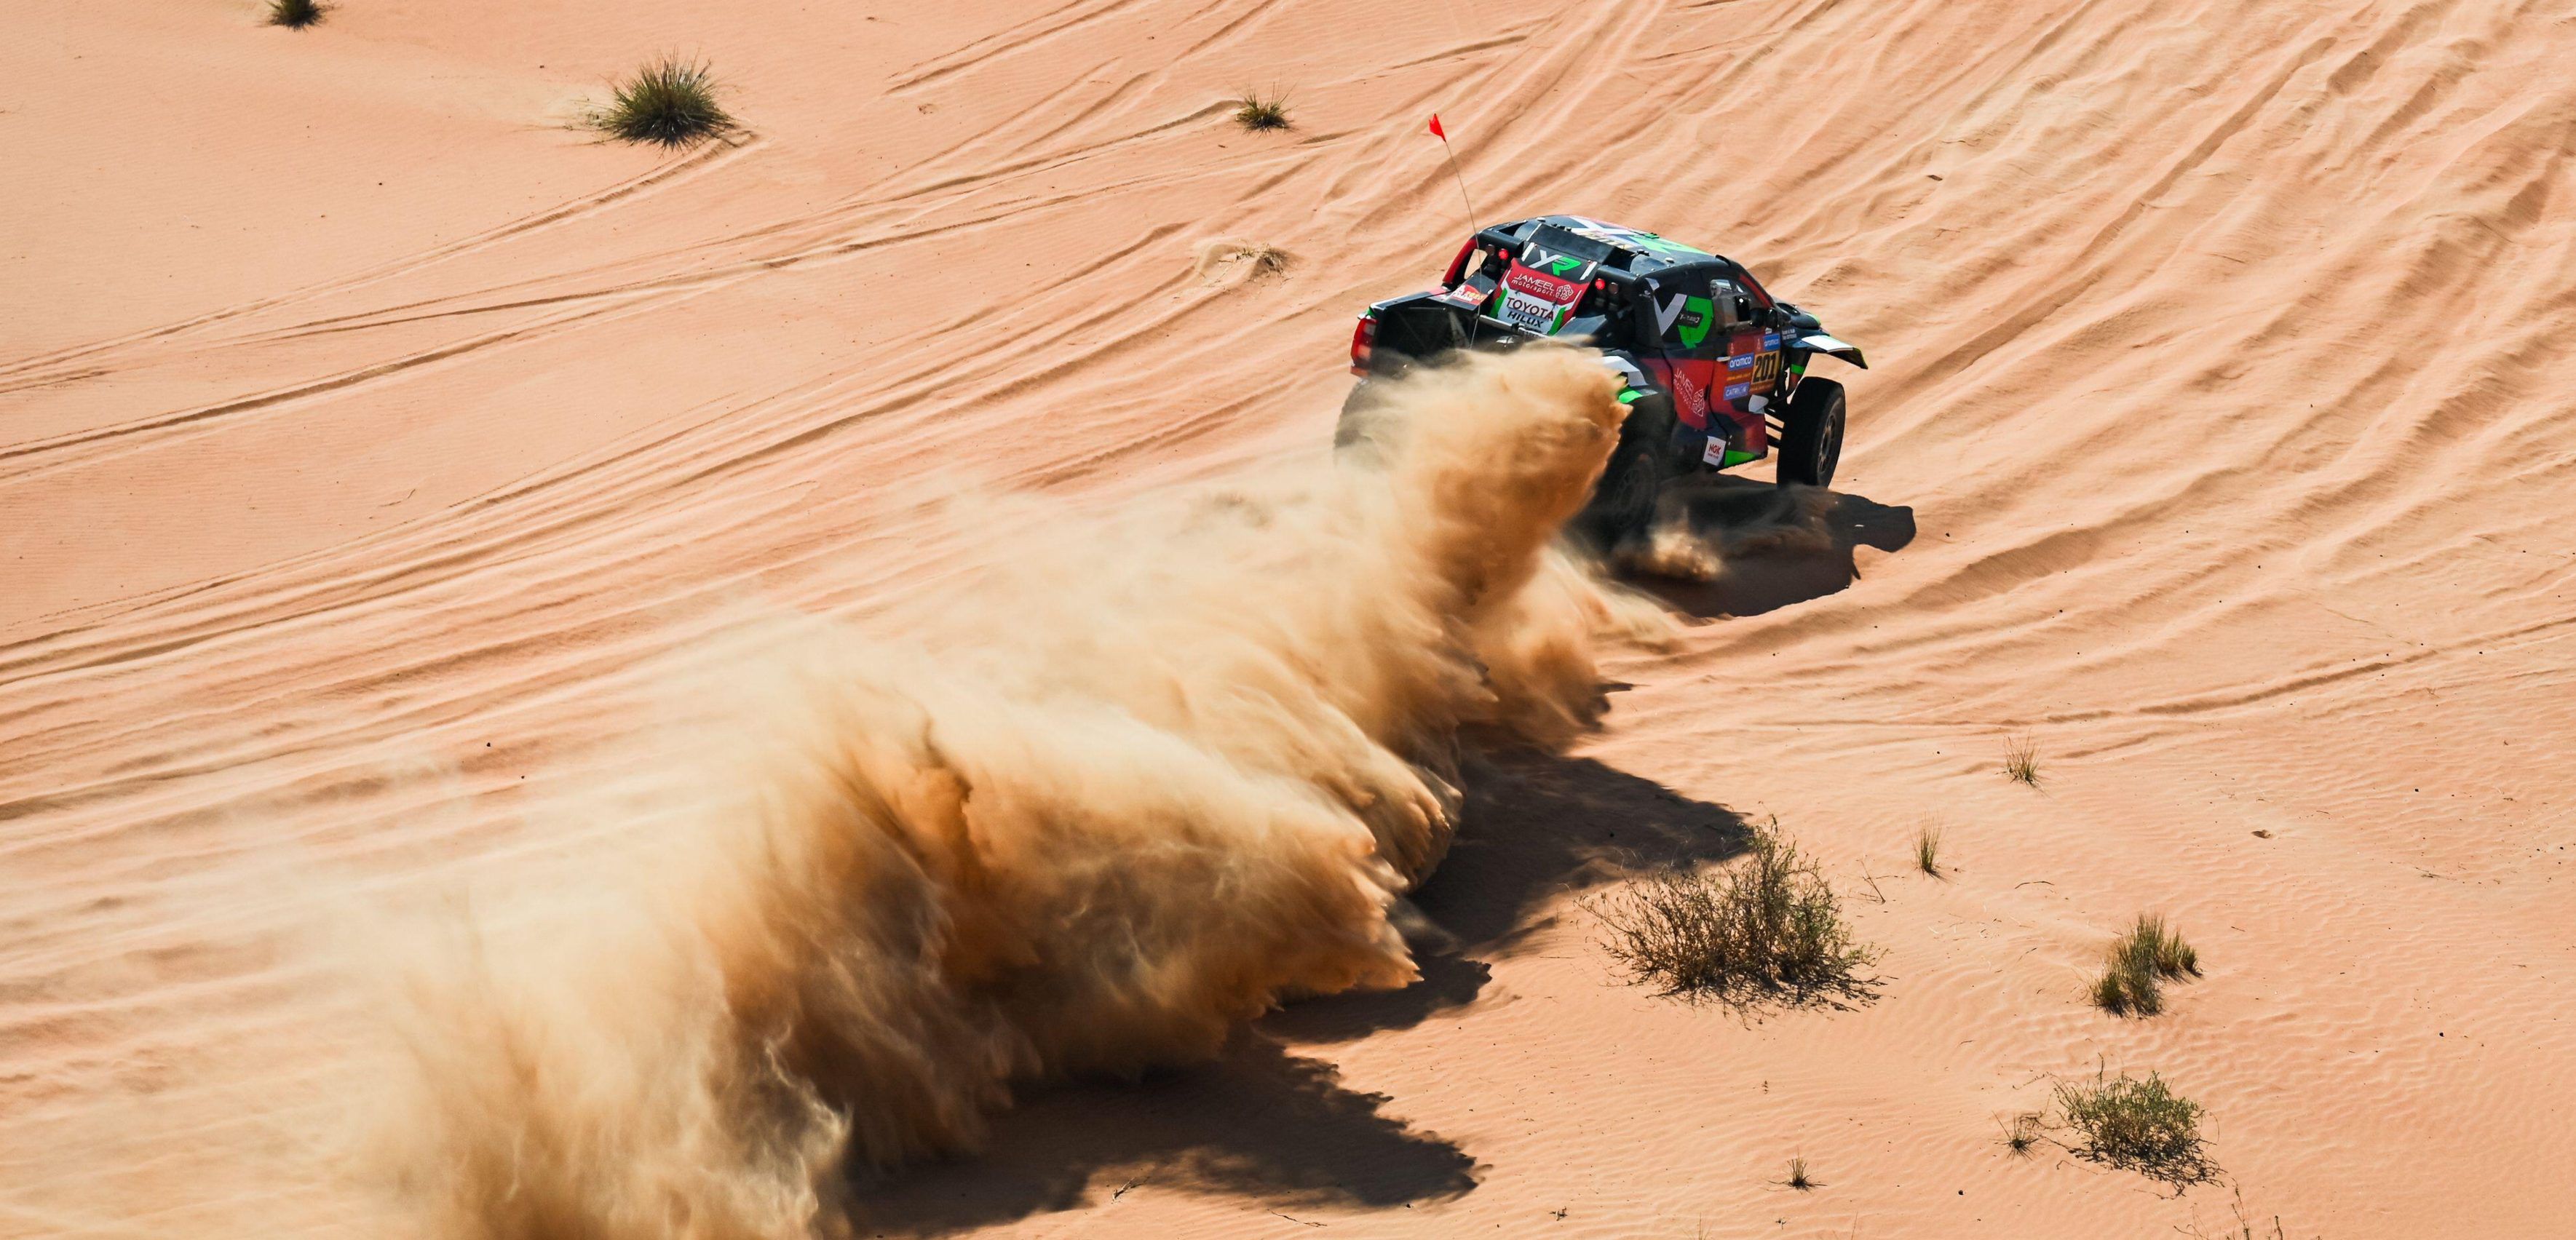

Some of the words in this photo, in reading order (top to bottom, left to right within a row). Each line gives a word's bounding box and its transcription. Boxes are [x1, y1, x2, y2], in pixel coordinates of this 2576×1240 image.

[1514, 274, 1555, 291] JAMEEL
[1507, 297, 1554, 321] TOYOTA
[1507, 311, 1545, 328] HILUX
[1729, 356, 1752, 368] aramco
[1753, 353, 1777, 382] 201
[1708, 443, 1721, 455] NGK
